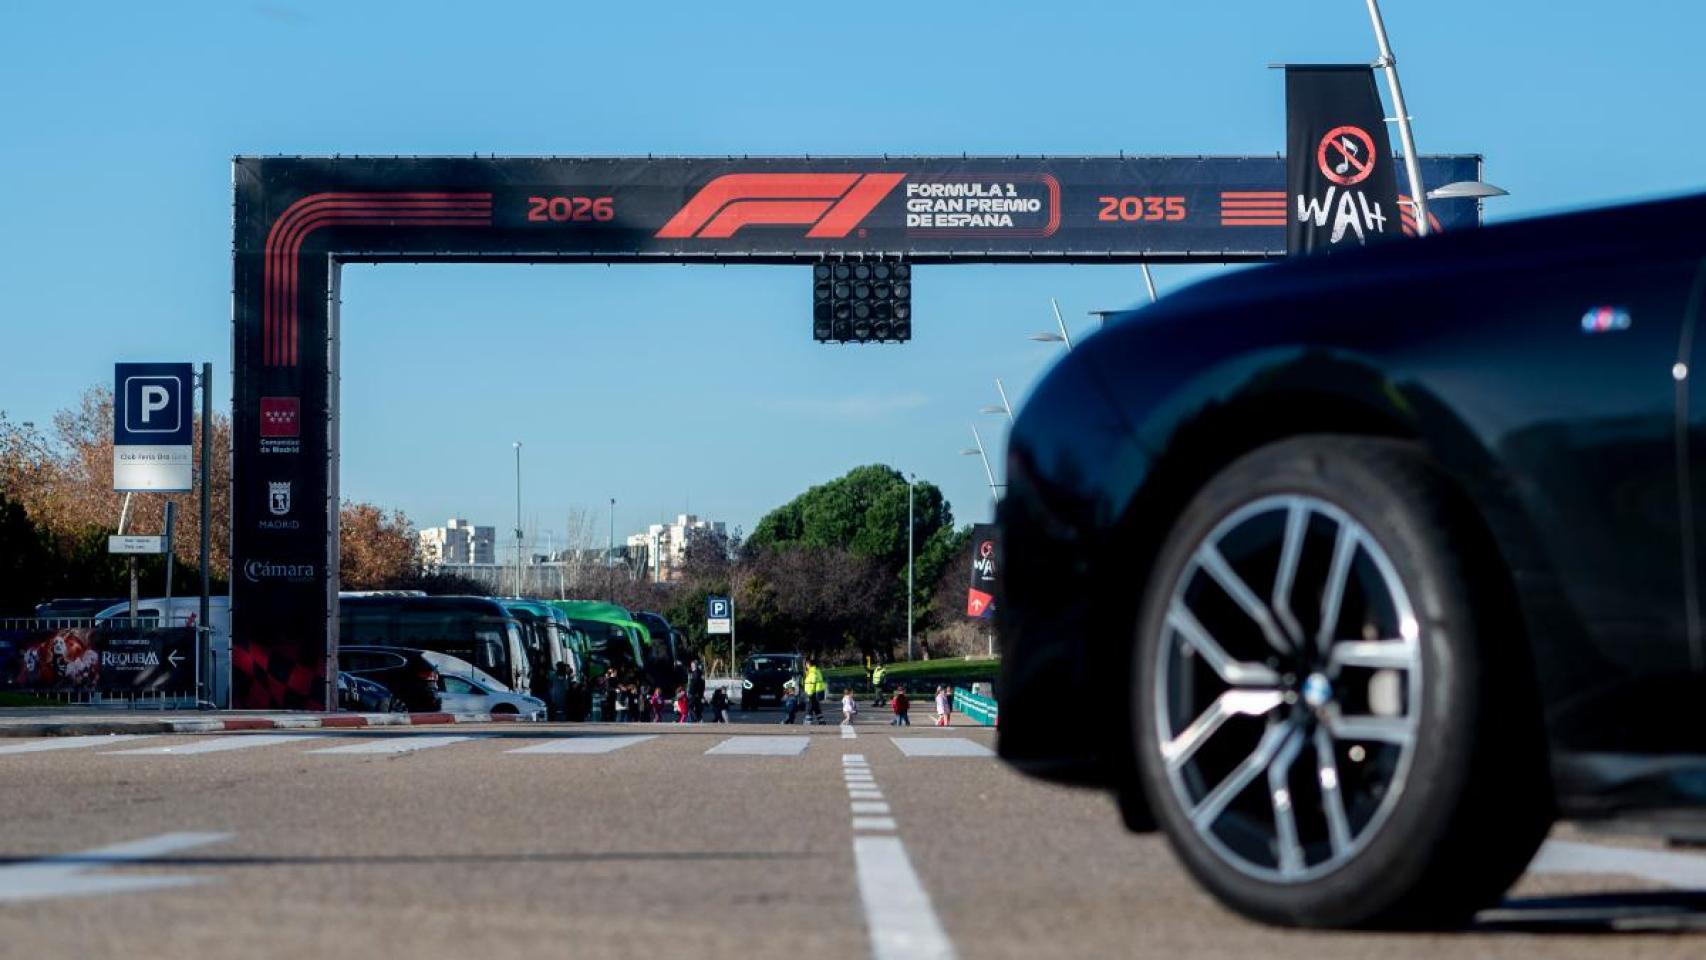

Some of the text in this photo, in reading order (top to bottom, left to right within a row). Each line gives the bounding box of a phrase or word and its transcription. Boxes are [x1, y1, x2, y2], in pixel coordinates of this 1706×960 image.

[906, 183, 1018, 197] FORMULA 1
[528, 197, 614, 222] 2026
[654, 173, 907, 238] F1
[906, 198, 1041, 213] GRAN PREMIO
[1098, 196, 1186, 221] 2035
[906, 213, 933, 227] DE
[1297, 186, 1387, 246] WAH
[141, 385, 170, 422] P
[259, 520, 300, 529] MADRID
[246, 560, 314, 578] Cámara
[714, 602, 725, 616] P
